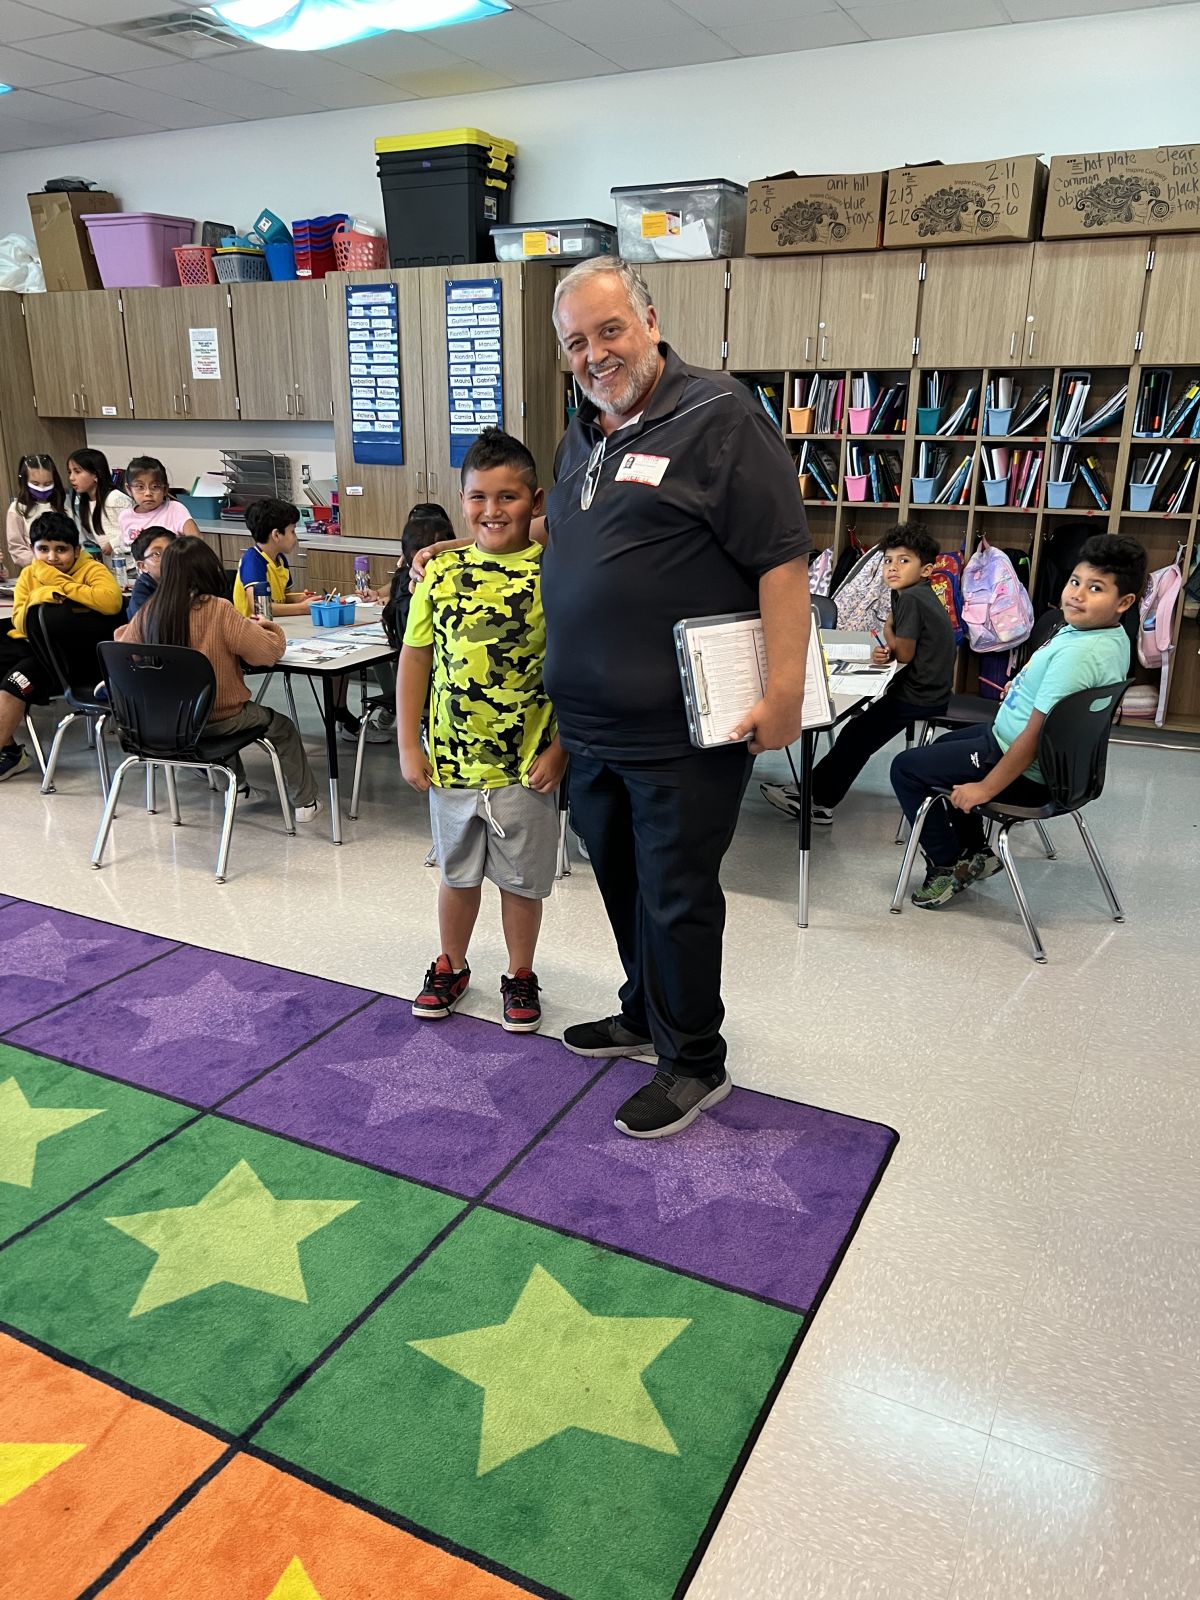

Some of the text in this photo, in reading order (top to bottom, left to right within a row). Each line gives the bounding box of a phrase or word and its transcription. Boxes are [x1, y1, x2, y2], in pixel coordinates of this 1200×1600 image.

[1084, 152, 1103, 172] hot
[1107, 150, 1137, 173] plate
[1172, 161, 1199, 176] bins
[985, 162, 1016, 181] 2.11
[826, 175, 869, 192] ant hill
[987, 182, 1020, 202] 2.10
[1167, 176, 1199, 202] black
[843, 195, 866, 210] blue
[889, 186, 914, 205] 2.13
[749, 198, 772, 215] 2.8
[990, 202, 1018, 216] 2.6
[846, 210, 875, 233] trays
[887, 208, 910, 226] 2.12
